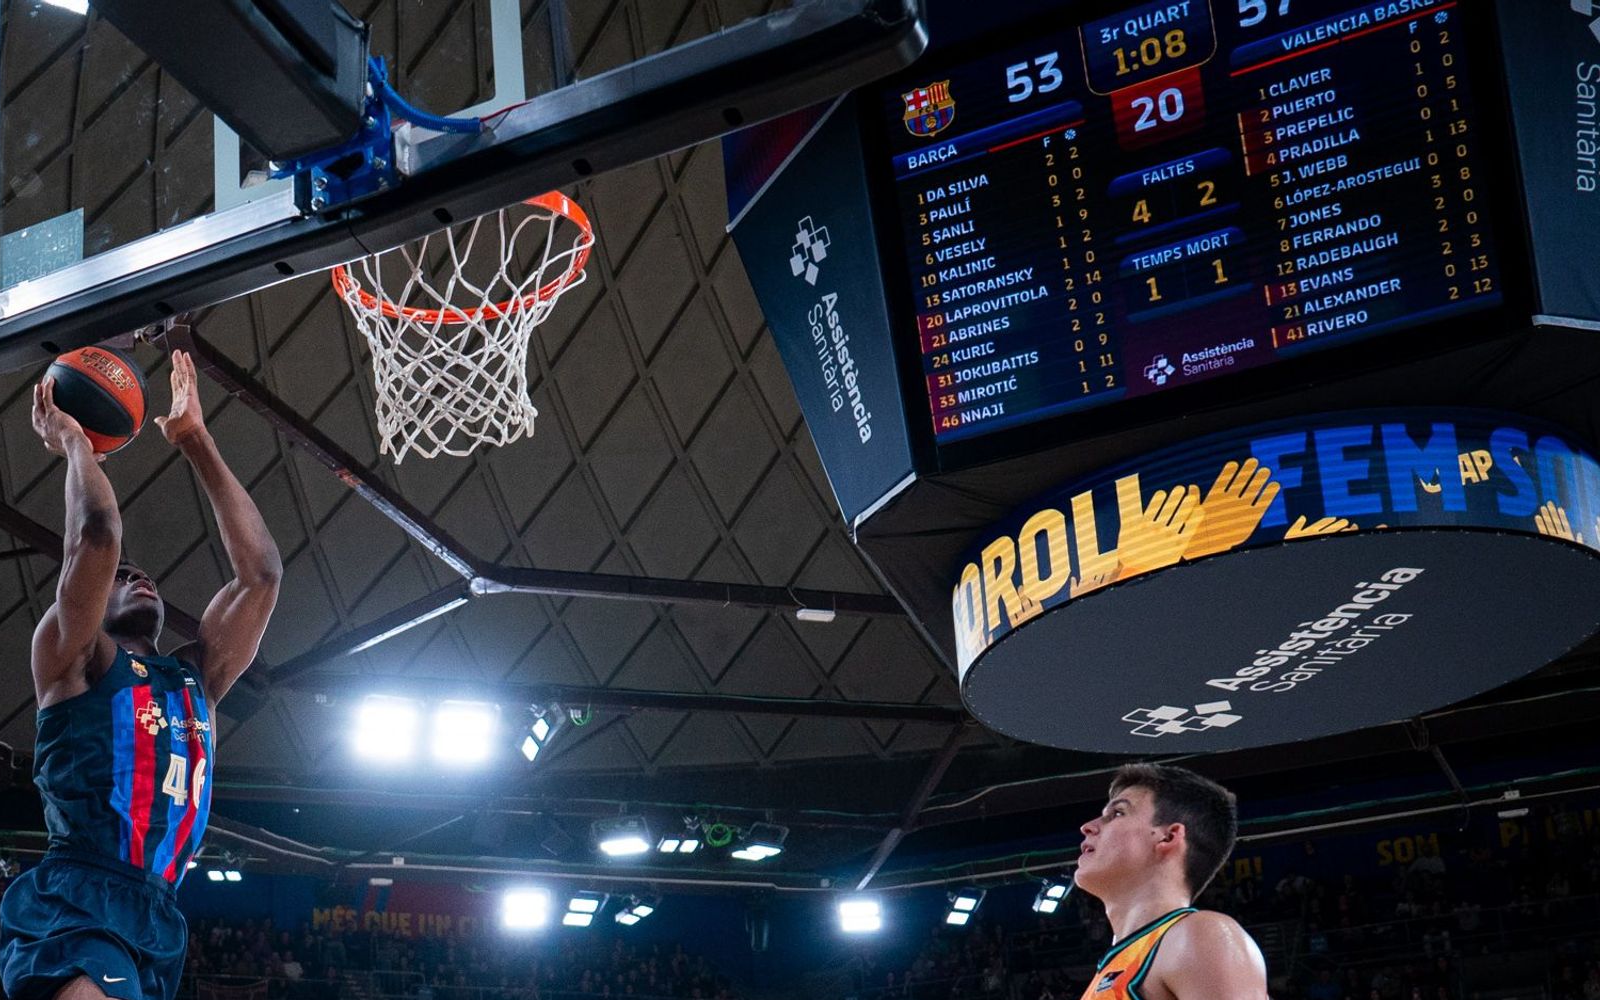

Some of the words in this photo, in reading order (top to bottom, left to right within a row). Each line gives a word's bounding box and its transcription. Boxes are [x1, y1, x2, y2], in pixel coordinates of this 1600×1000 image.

[1100, 27, 1120, 44] 3r
[1124, 0, 1190, 36] QUART
[1281, 12, 1370, 51] VALENCIA
[1408, 20, 1417, 34] F
[1006, 51, 1063, 103] 53
[1112, 29, 1187, 76] 1:08
[1259, 88, 1266, 100] 1
[1269, 68, 1332, 97] CLAVER
[1410, 39, 1421, 54] 0
[1439, 30, 1450, 45] 2
[1130, 87, 1184, 132] 20
[1260, 109, 1270, 123] 2
[1272, 89, 1336, 119] PUERTO
[1415, 62, 1424, 76] 1
[1442, 53, 1453, 67] 0
[1263, 131, 1274, 144] 3
[1276, 107, 1354, 141] PREPELIC
[1416, 84, 1428, 98] 0
[1446, 75, 1457, 89] 5
[1043, 136, 1051, 148] F
[1266, 152, 1277, 165] 4
[1279, 128, 1360, 162] PRADILLA
[1420, 107, 1431, 120] 0
[1450, 98, 1459, 112] 1
[1270, 174, 1280, 187] 5
[1282, 170, 1296, 184] J.
[1298, 154, 1348, 179] WEBB
[1425, 129, 1434, 143] 1
[1449, 119, 1468, 136] 13
[1576, 61, 1600, 192] Sanitària
[907, 144, 958, 170] BARÇA
[918, 193, 925, 205] 1
[926, 187, 946, 203] DA
[948, 174, 989, 196] SILVA
[1045, 153, 1055, 167] 2
[1068, 146, 1079, 159] 2
[1142, 160, 1195, 186] FALTES
[1274, 196, 1284, 209] 6
[1285, 157, 1421, 206] LÓPEZ-AROSTEGUI
[1427, 152, 1439, 166] 0
[1456, 144, 1467, 158] 0
[919, 213, 928, 226] 3
[929, 196, 971, 223] PAULÍ
[1048, 174, 1058, 187] 0
[1072, 167, 1082, 179] 0
[922, 233, 931, 246] 5
[1051, 194, 1061, 208] 3
[1075, 187, 1085, 200] 2
[1132, 199, 1152, 223] 4
[1197, 181, 1217, 206] 2
[1277, 218, 1286, 231] 7
[1289, 202, 1342, 228] JONES
[1431, 174, 1441, 188] 3
[1459, 166, 1471, 180] 8
[1280, 239, 1290, 253] 8
[1293, 214, 1381, 249] FERRANDO
[1434, 196, 1445, 210] 2
[1463, 188, 1474, 202] 0
[921, 273, 937, 288] 10
[938, 256, 996, 283] KALINIC
[1059, 236, 1067, 249] 1
[1082, 229, 1092, 242] 2
[925, 253, 934, 265] 6
[935, 237, 986, 262] VESELY
[1056, 216, 1063, 228] 1
[1079, 208, 1088, 220] 9
[1132, 246, 1183, 271] TEMPS
[1186, 232, 1229, 256] MORT
[1276, 261, 1294, 276] 12
[1296, 232, 1399, 271] RADEBAUGH
[1438, 219, 1449, 233] 2
[1466, 211, 1478, 225] 0
[1280, 282, 1297, 298] 13
[1299, 267, 1354, 293] EVANS
[1442, 241, 1453, 255] 2
[1470, 233, 1481, 247] 3
[926, 294, 941, 308] 13
[942, 267, 1033, 303] SATORANSKY
[1062, 257, 1071, 270] 1
[1085, 250, 1095, 263] 0
[926, 314, 943, 329] 20
[945, 285, 1049, 324] LAPROVITTOLA
[1064, 278, 1074, 291] 2
[1085, 270, 1102, 285] 14
[1146, 277, 1162, 302] 1
[1212, 258, 1229, 284] 1
[1283, 304, 1301, 319] 21
[1304, 278, 1401, 315] ALEXANDER
[1444, 264, 1456, 278] 0
[1470, 255, 1489, 271] 13
[931, 333, 947, 348] 21
[949, 316, 1010, 343] ABRINES
[1068, 298, 1078, 311] 2
[1091, 291, 1102, 304] 0
[1286, 326, 1305, 341] 41
[1306, 310, 1368, 336] RIVERO
[1448, 286, 1459, 300] 2
[1473, 277, 1492, 294] 12
[808, 303, 844, 412] Sanitària
[821, 292, 872, 444] Assistència
[932, 353, 950, 368] 24
[951, 341, 995, 363] KURIC
[1071, 319, 1081, 332] 2
[1095, 312, 1105, 325] 2
[938, 374, 953, 388] 31
[954, 351, 1039, 384] JOKUBAITIS
[1074, 339, 1084, 352] 0
[1098, 333, 1108, 346] 9
[1181, 337, 1255, 368] Assistència
[1182, 355, 1235, 376] Sanitària
[939, 394, 956, 408] 33
[957, 374, 1018, 404] MIROTIĆ
[1079, 360, 1086, 373] 1
[1099, 353, 1114, 367] 11
[941, 414, 959, 428] 46
[961, 402, 1005, 424] NNAJI
[1082, 381, 1090, 394] 1
[1104, 375, 1115, 388] 2
[1250, 422, 1467, 530] FEM
[1205, 567, 1425, 691] Assistència
[1249, 612, 1413, 693] Sanitària
